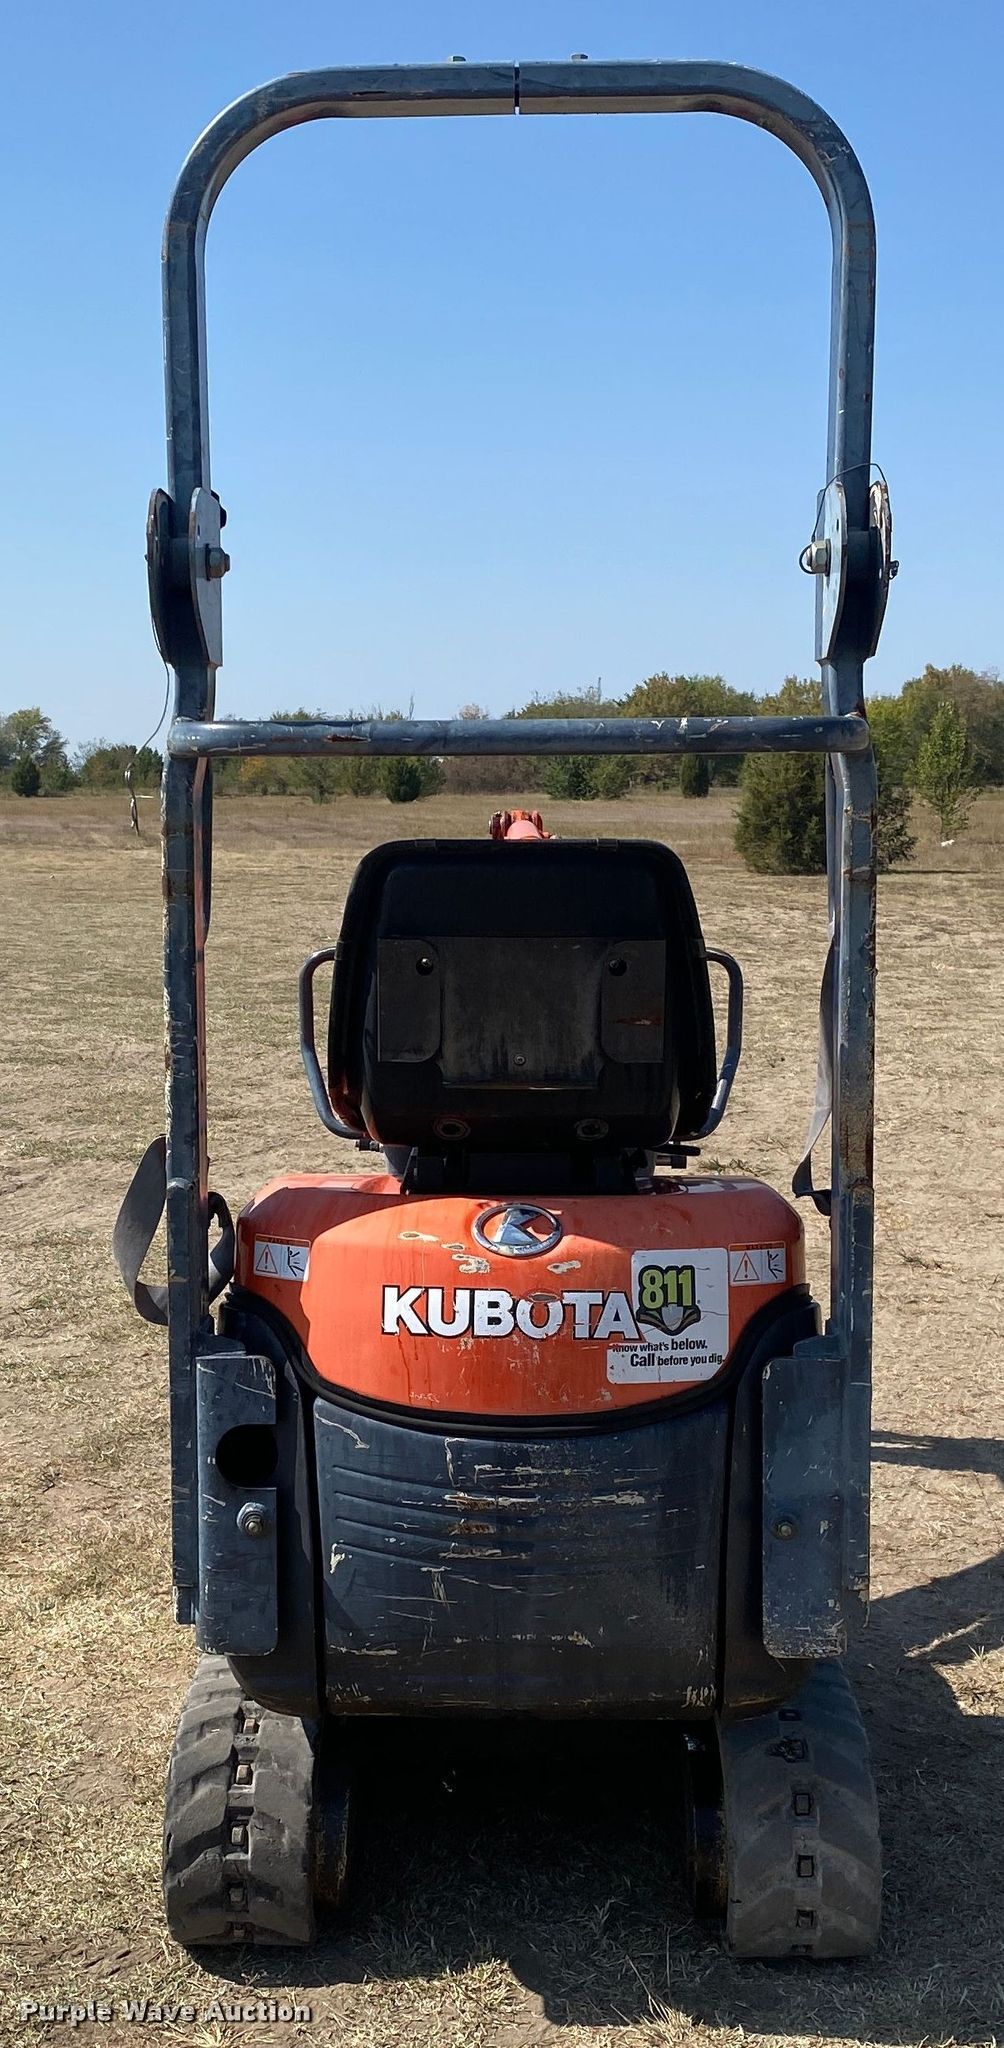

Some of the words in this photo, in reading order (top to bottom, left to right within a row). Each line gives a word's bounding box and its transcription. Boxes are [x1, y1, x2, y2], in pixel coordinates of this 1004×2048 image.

[639, 1266, 695, 1310] 811
[382, 1285, 641, 1341] KUBOTA
[612, 1344, 638, 1352] Know
[640, 1342, 669, 1352] what's
[671, 1338, 707, 1350] below.
[630, 1353, 655, 1367] Call
[657, 1355, 688, 1366] before
[690, 1356, 707, 1366] you
